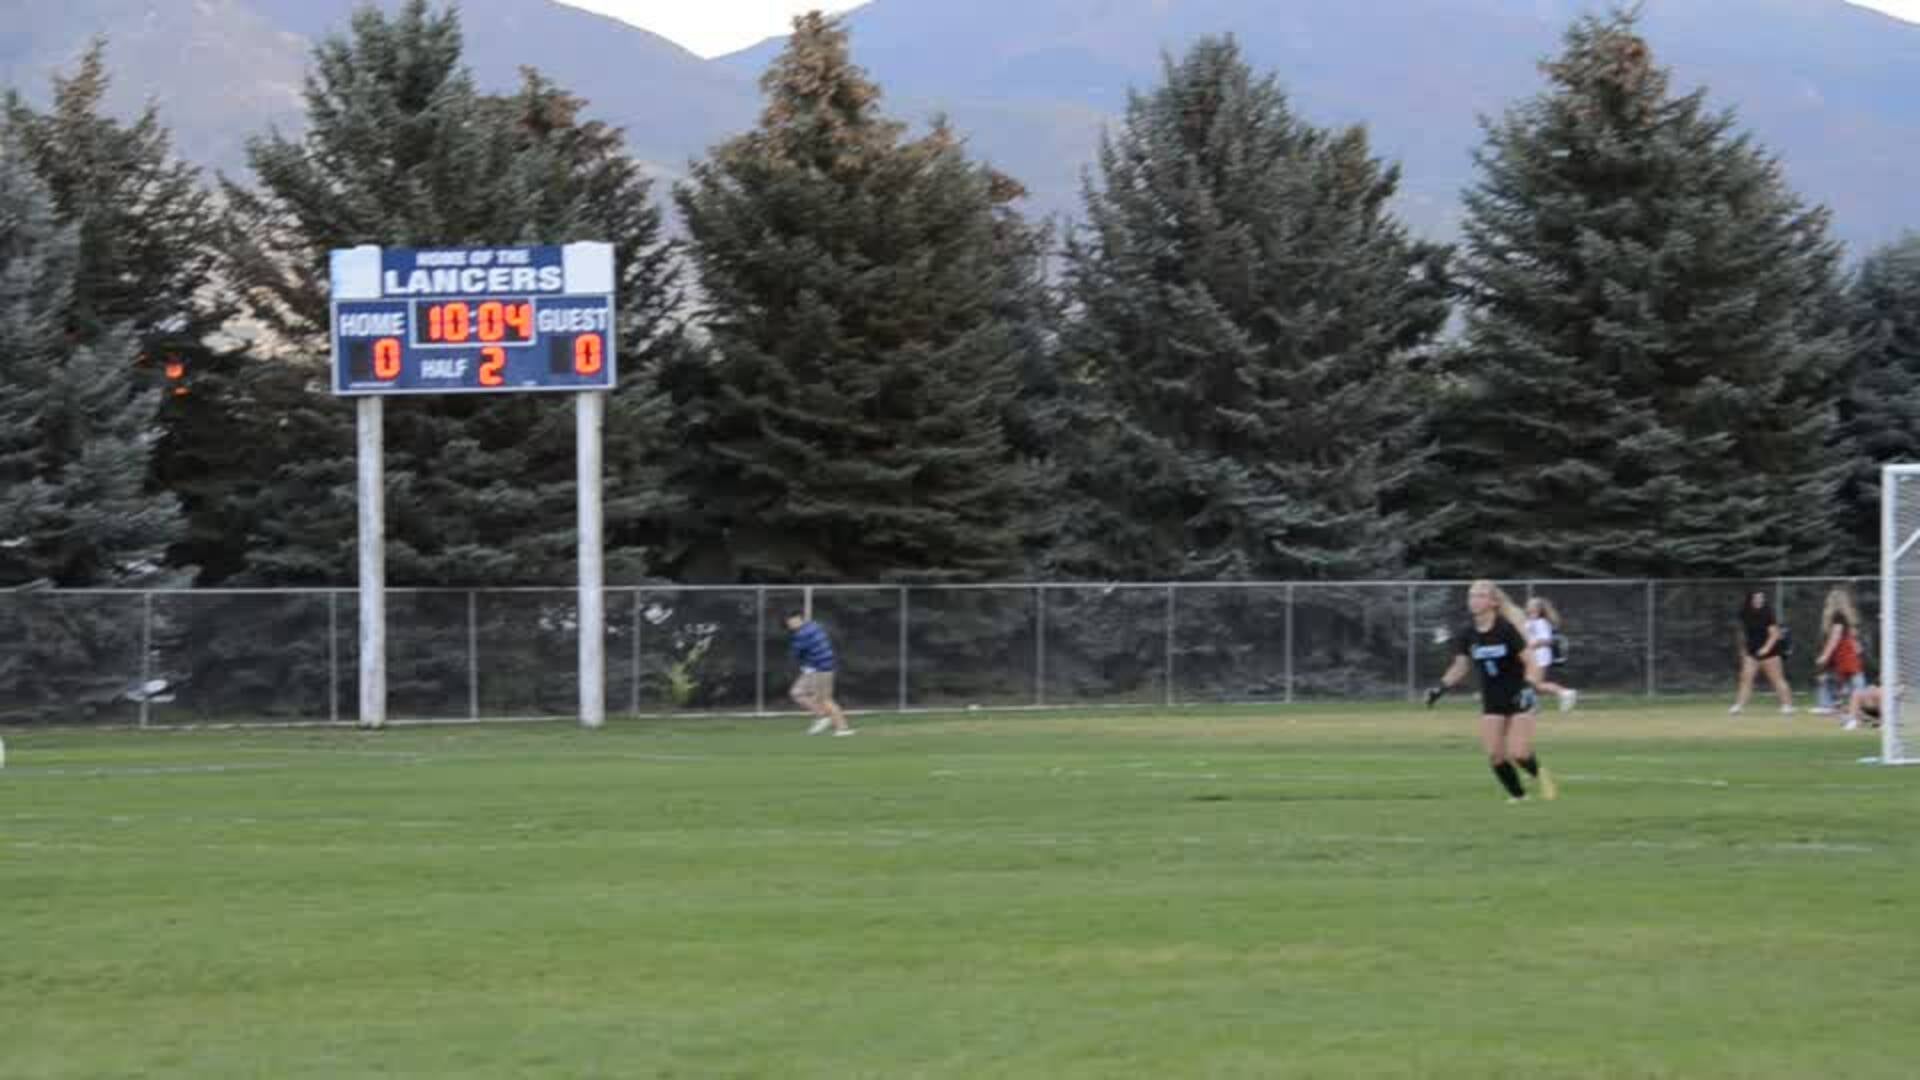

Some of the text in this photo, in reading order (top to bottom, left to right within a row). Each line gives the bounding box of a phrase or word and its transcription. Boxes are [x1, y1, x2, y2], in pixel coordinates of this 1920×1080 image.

[416, 249, 530, 266] HOME OF THE
[385, 267, 561, 294] LANCERS
[339, 311, 406, 337] HOME
[428, 301, 532, 342] 10:04
[537, 308, 609, 332] GUEST
[373, 337, 401, 380] 0
[420, 346, 505, 385] HALF 2
[574, 332, 602, 375] 0
